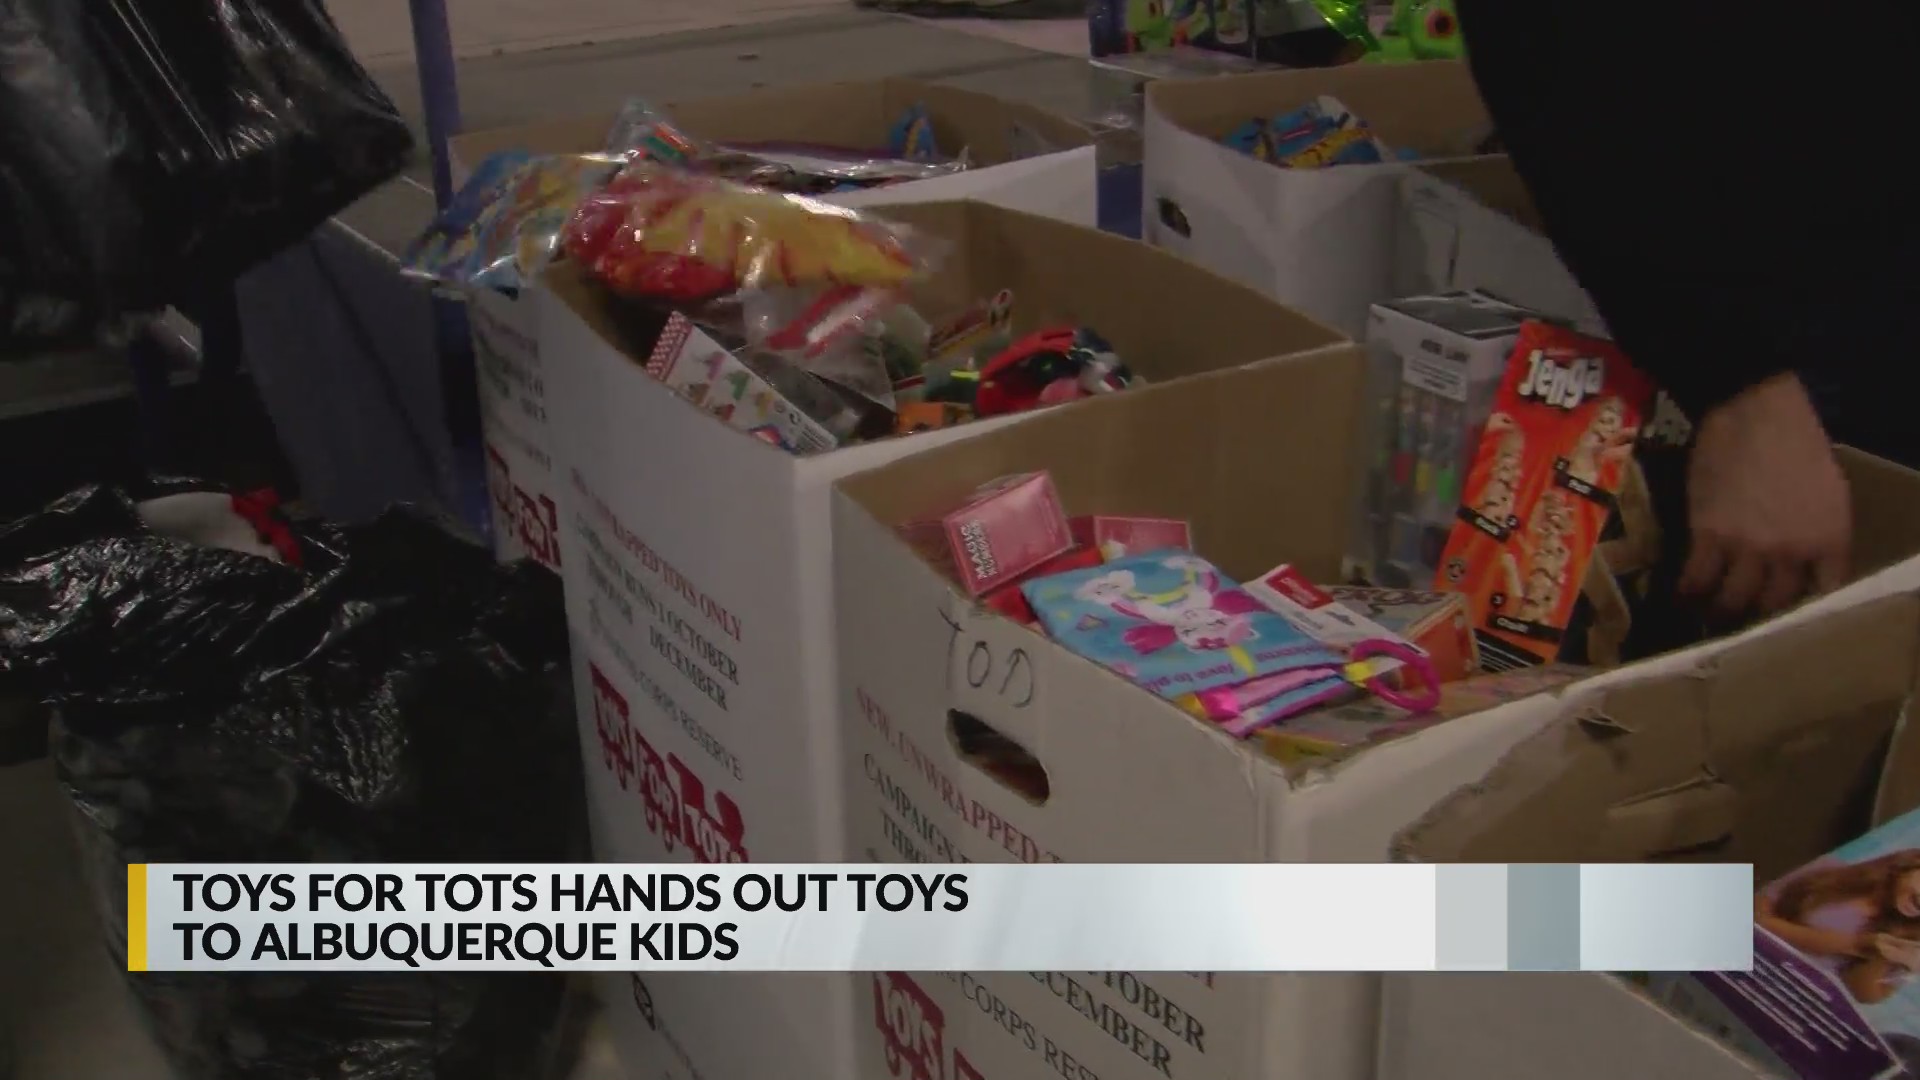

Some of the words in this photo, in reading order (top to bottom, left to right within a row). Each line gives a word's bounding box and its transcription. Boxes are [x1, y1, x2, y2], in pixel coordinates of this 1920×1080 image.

[1518, 350, 1605, 409] Jenga
[660, 558, 697, 608] TOYS
[700, 593, 742, 642] ONLY
[649, 624, 729, 713] DECEMBER
[667, 610, 740, 686] OCTOBER
[679, 708, 744, 782] RESERVE
[864, 753, 957, 863] CAMPAIGN
[897, 731, 1040, 863] UNWRAPPED
[960, 971, 1037, 1051] CORPS
[1088, 971, 1205, 1055] TOBER
